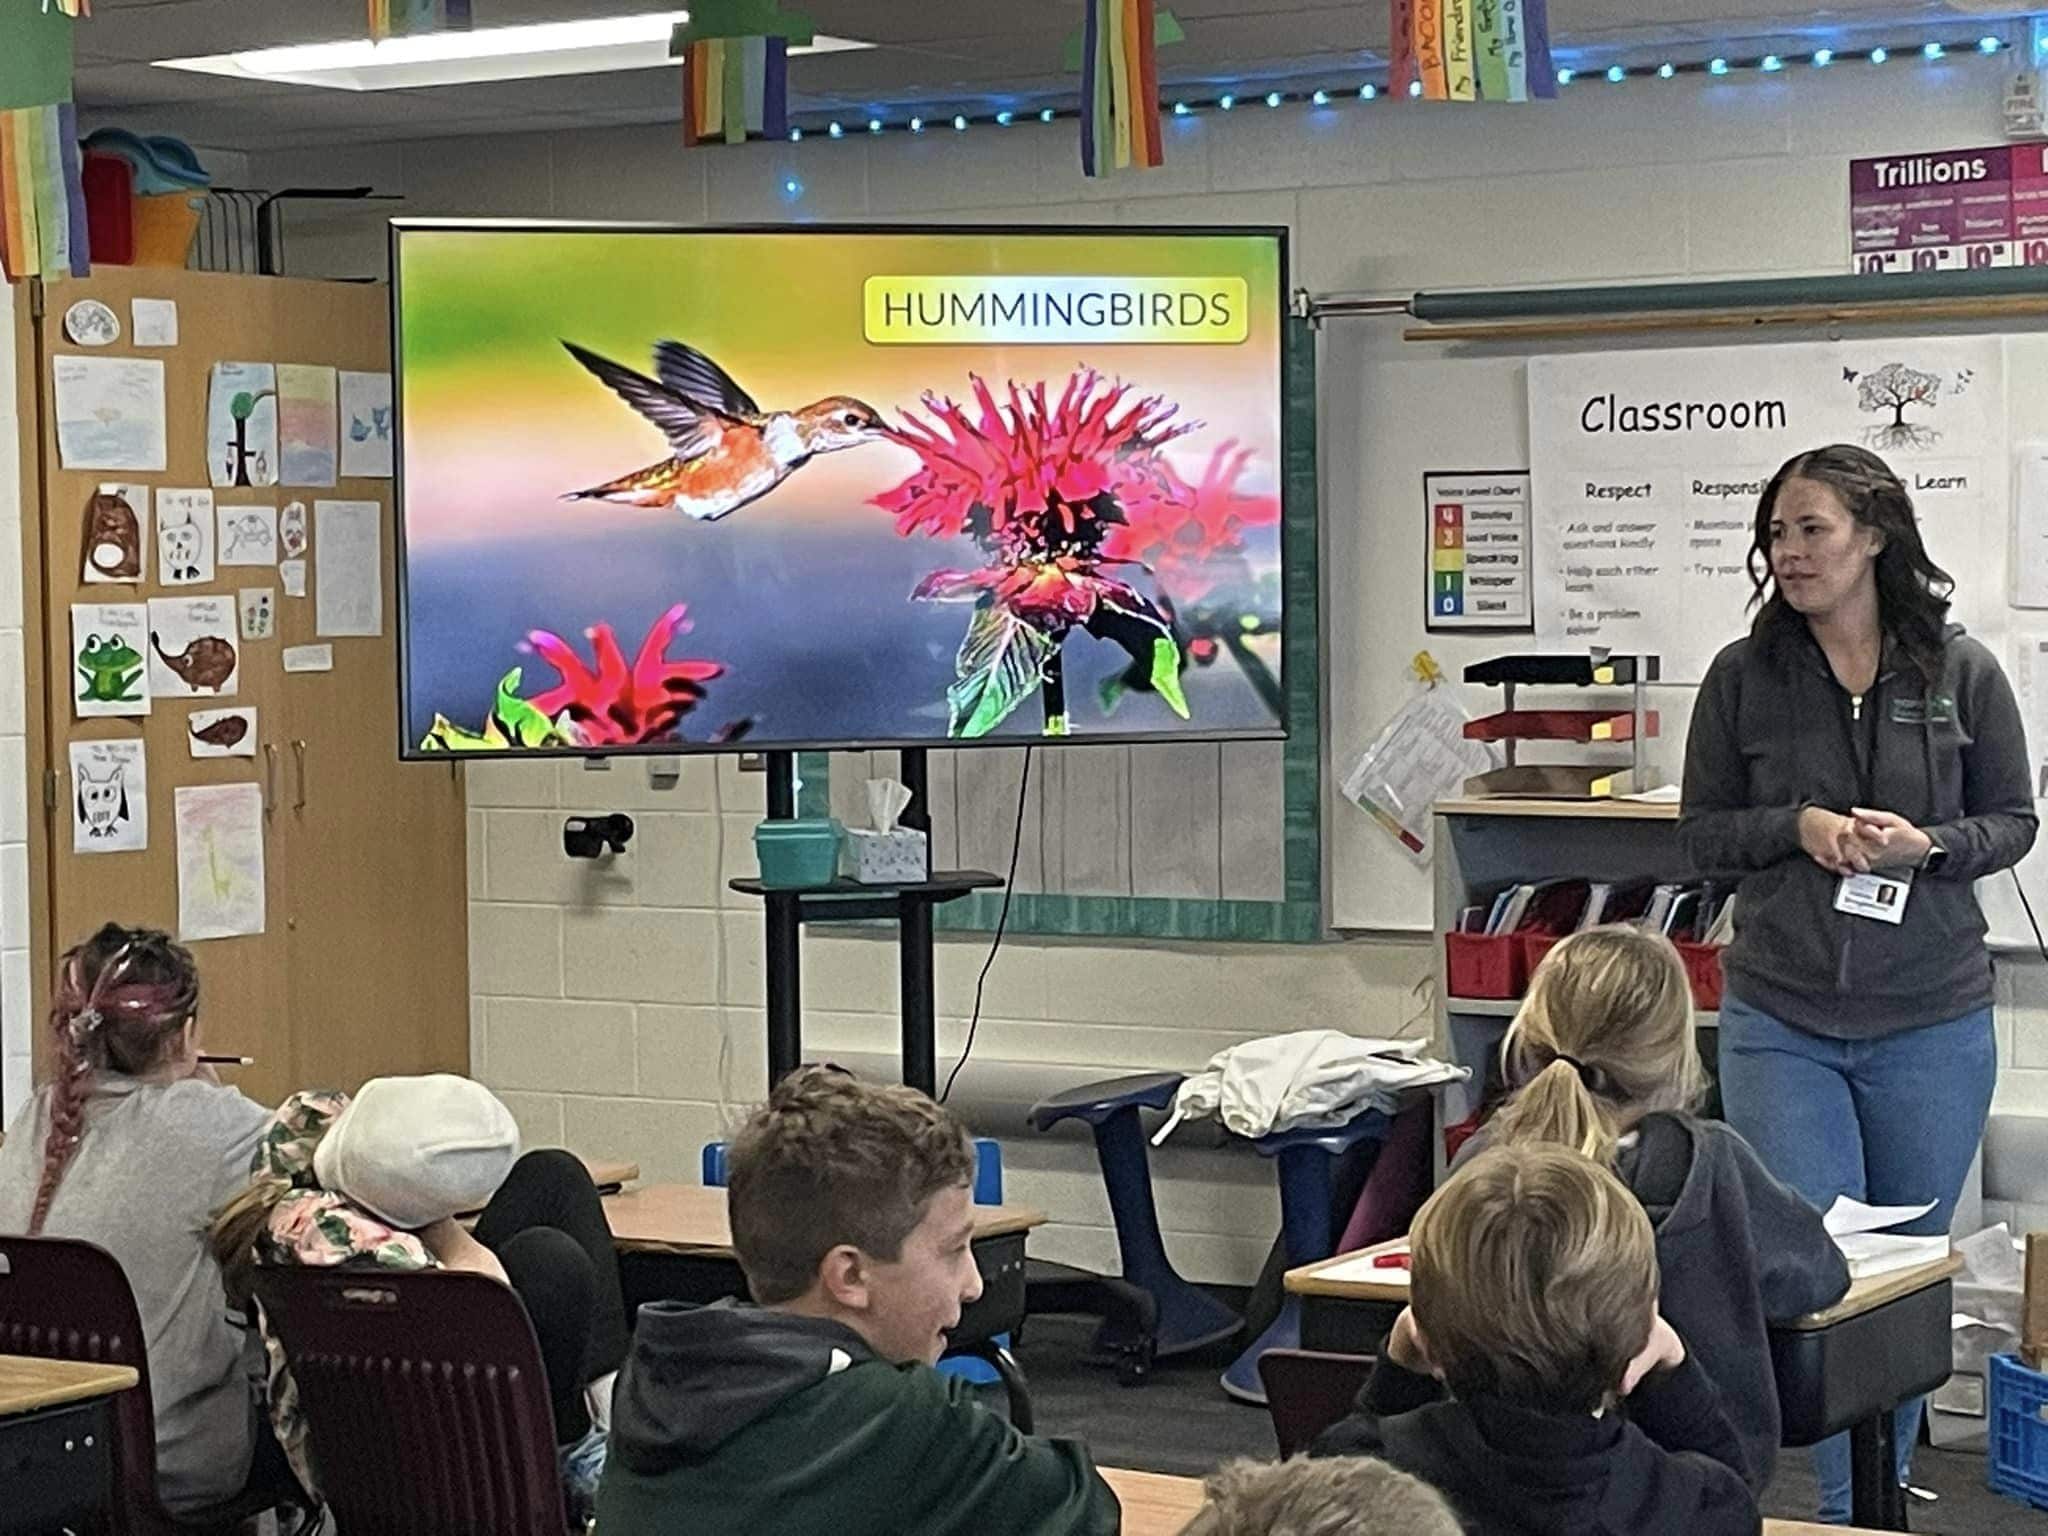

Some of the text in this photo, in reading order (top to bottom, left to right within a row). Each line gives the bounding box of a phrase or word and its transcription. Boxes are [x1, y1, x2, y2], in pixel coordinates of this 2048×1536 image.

[1873, 158, 1987, 188] Trillions
[884, 292, 1231, 328] HUMMINGBIRDS
[1581, 393, 1786, 433] Classroom
[1915, 473, 1968, 490] Learn
[1585, 482, 1652, 501] Respect
[1442, 507, 1454, 523] 4
[1592, 521, 1613, 533] and
[1442, 597, 1454, 613] 0
